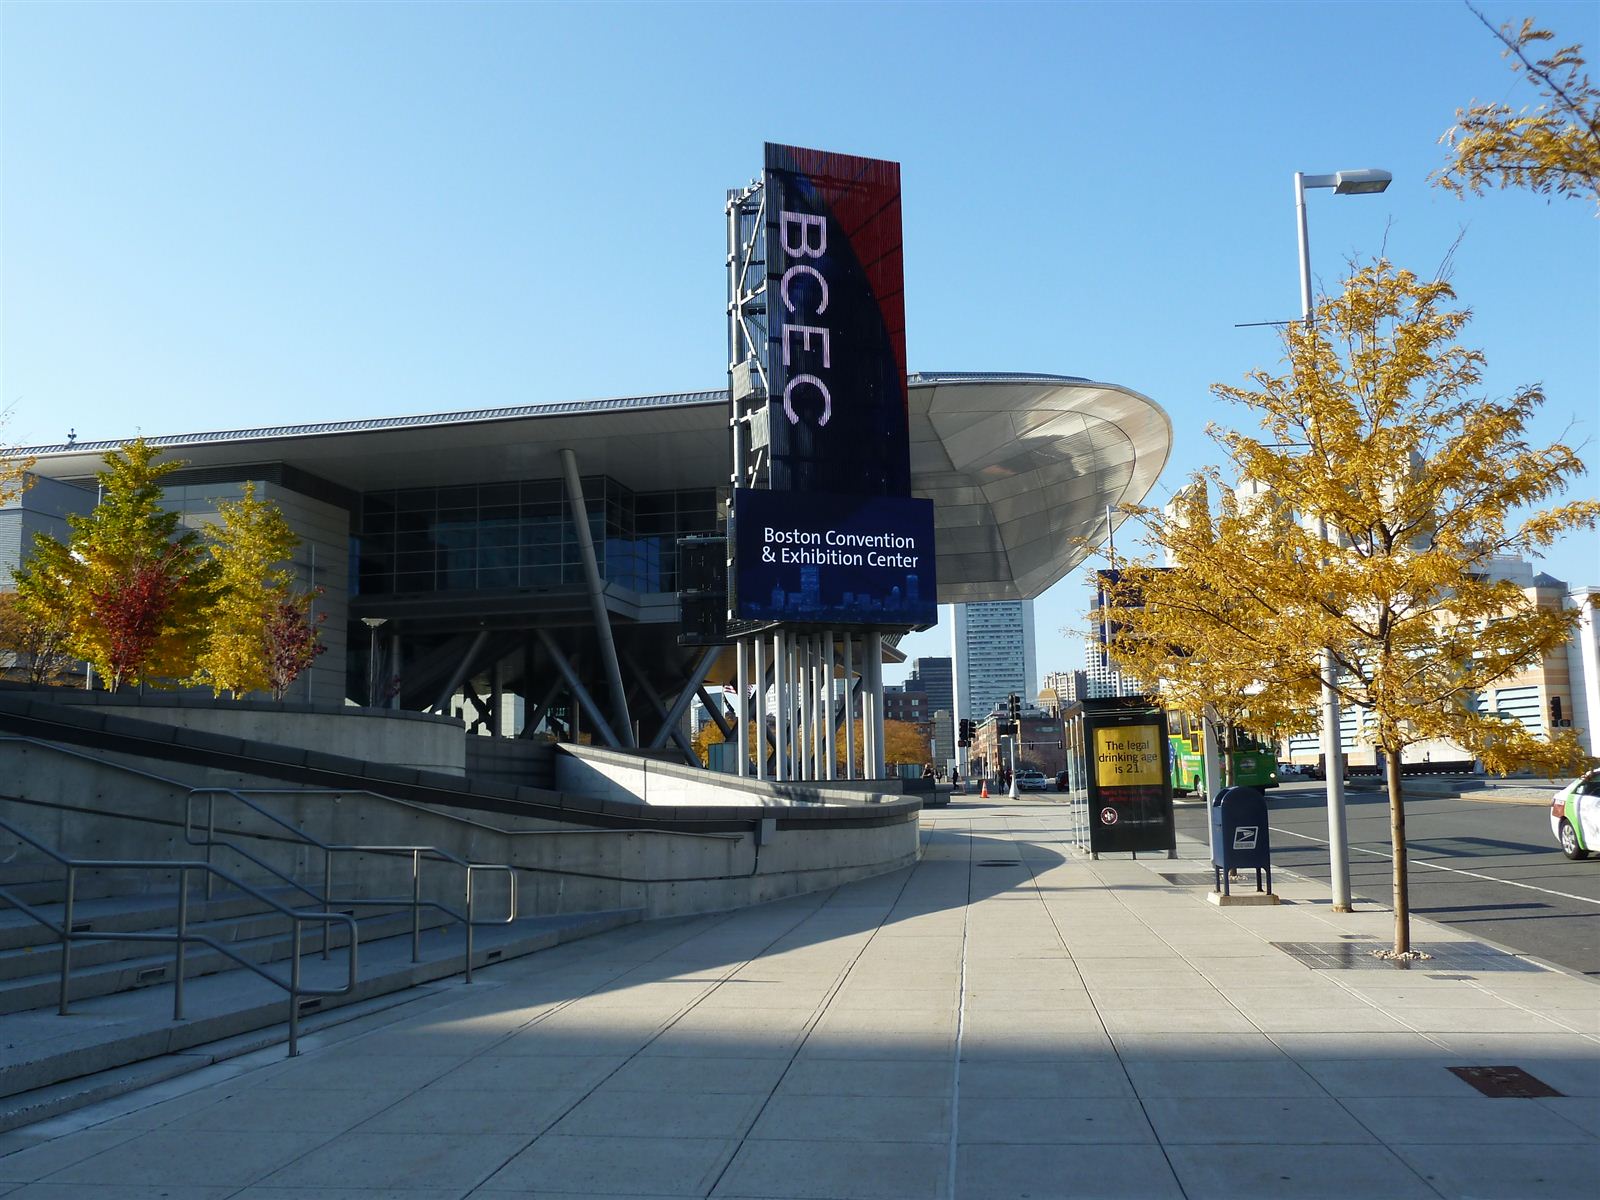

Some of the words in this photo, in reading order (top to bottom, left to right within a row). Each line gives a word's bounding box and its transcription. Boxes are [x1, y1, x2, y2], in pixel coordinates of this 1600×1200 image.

[779, 210, 832, 428] BCEC
[764, 527, 821, 545] Boston
[825, 530, 915, 549] Convention
[762, 546, 776, 563] &
[781, 547, 863, 566] Exhibition
[867, 551, 919, 568] Center
[1105, 741, 1124, 750] The
[1127, 740, 1150, 752] legal
[1098, 752, 1139, 763] drinking
[1141, 753, 1158, 763] age
[1114, 764, 1123, 774] is
[1126, 764, 1143, 773] 21.
